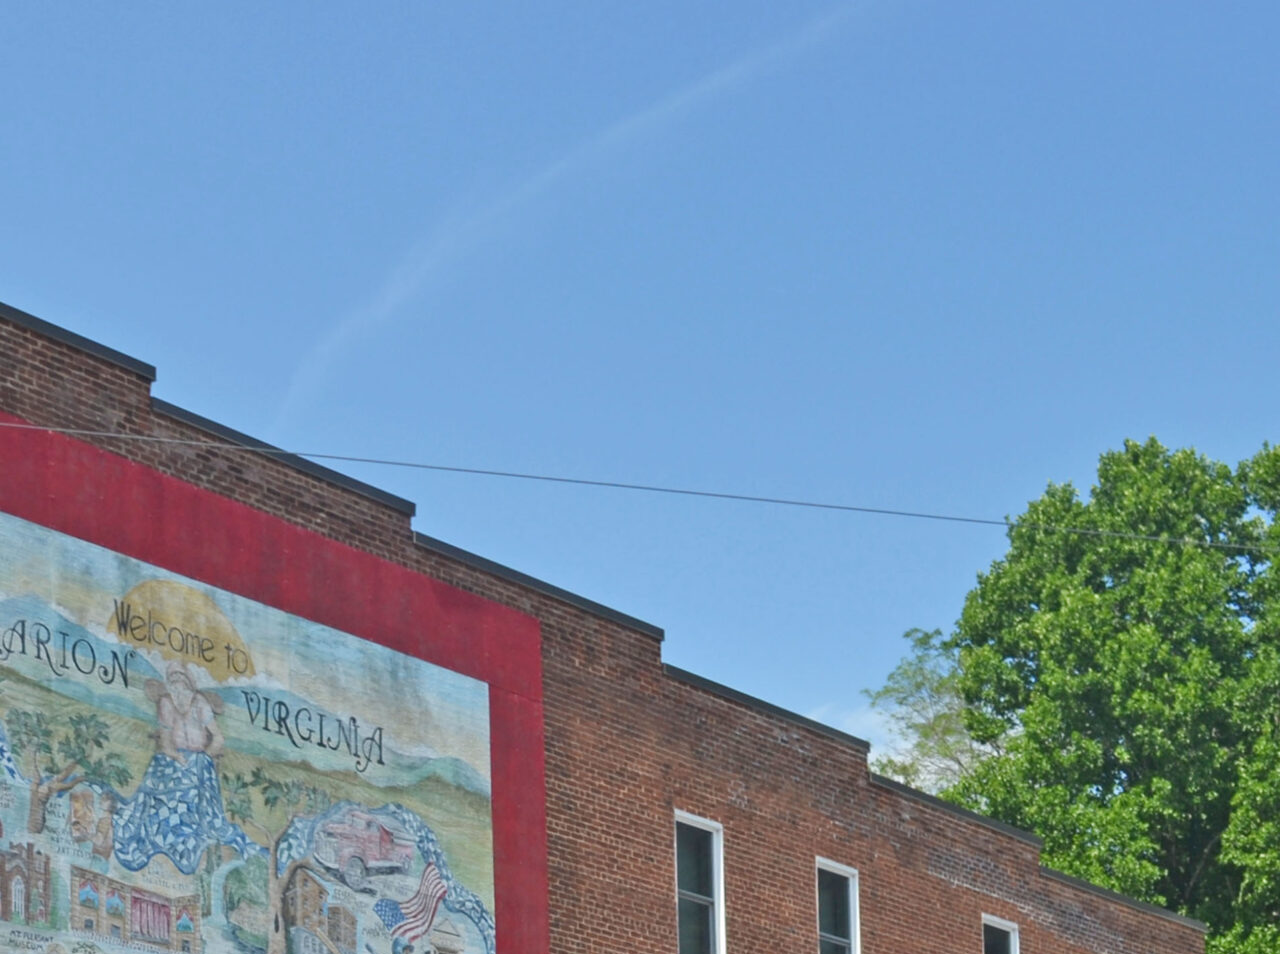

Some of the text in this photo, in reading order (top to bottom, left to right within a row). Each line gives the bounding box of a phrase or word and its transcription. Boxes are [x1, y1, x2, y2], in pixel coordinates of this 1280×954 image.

[113, 598, 248, 675] Welcome to
[241, 690, 386, 773] VIRGINIA
